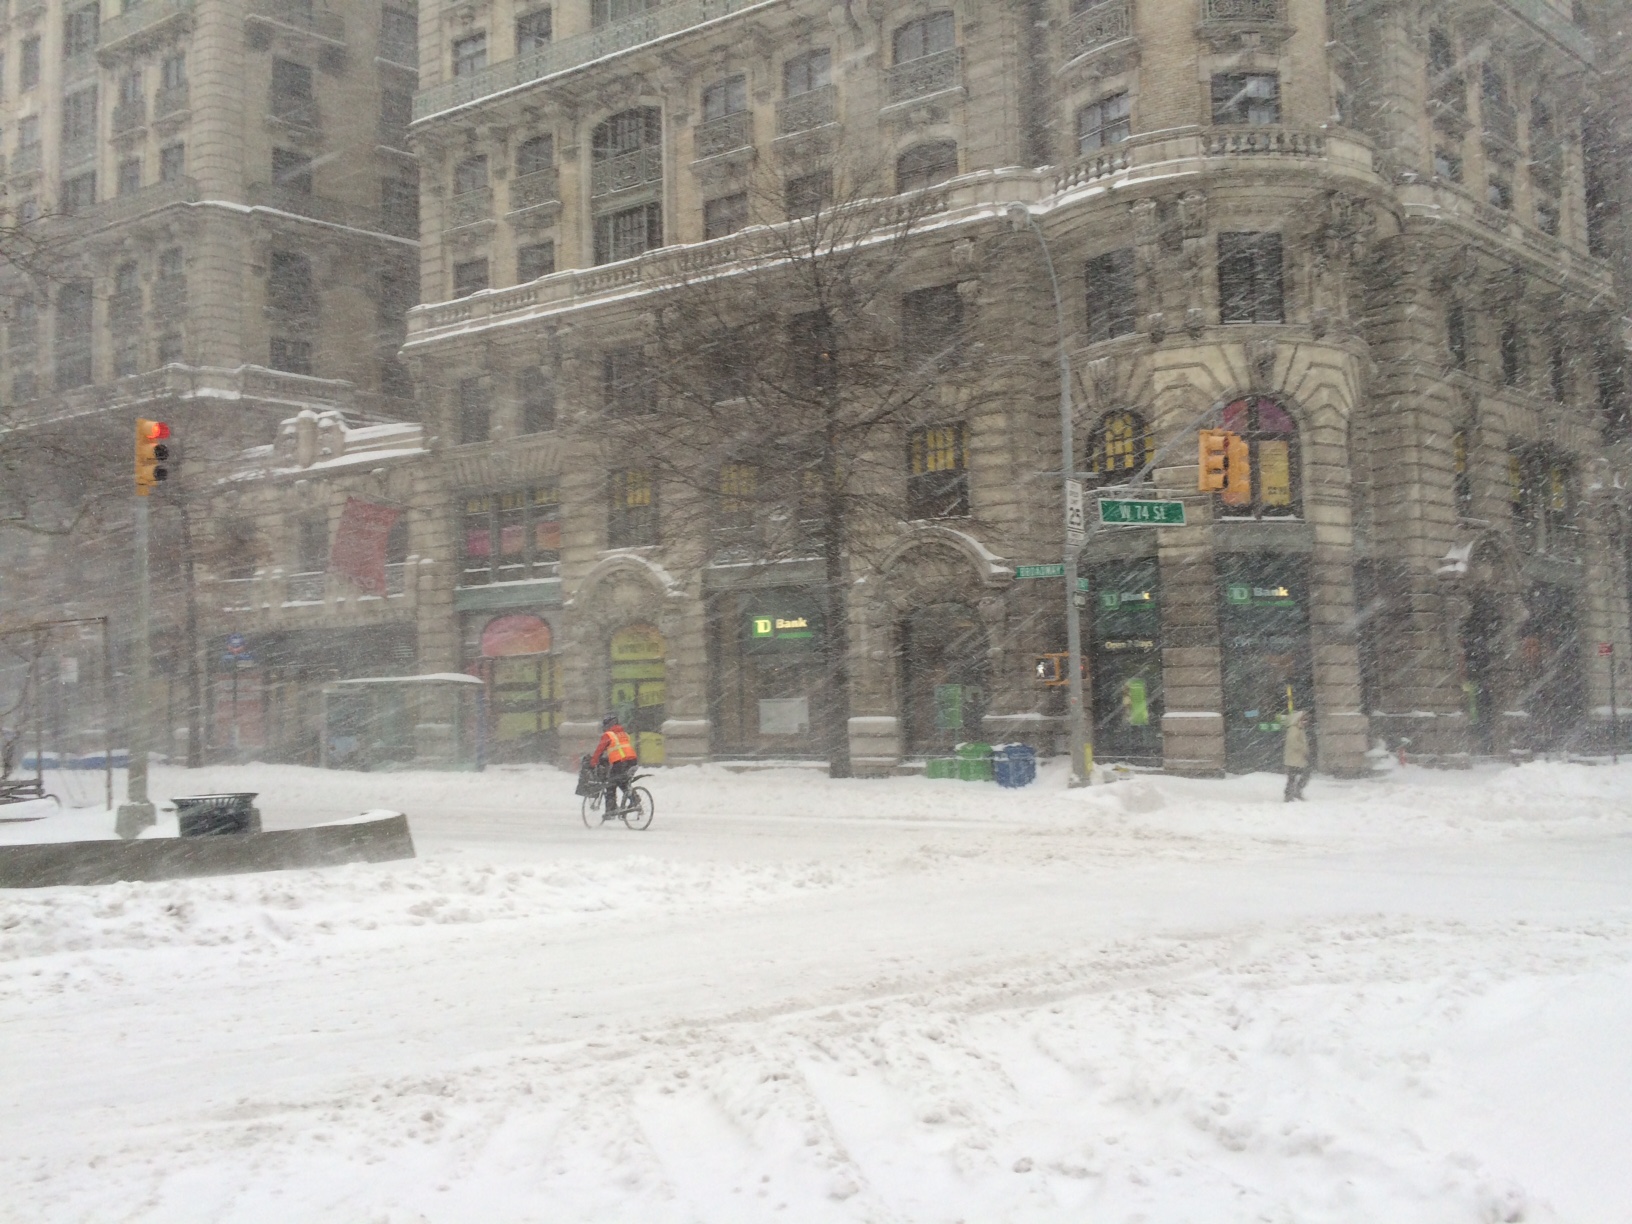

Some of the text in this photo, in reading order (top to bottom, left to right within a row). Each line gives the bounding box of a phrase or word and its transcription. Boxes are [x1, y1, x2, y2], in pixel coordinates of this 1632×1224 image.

[1069, 507, 1081, 526] 25
[1119, 505, 1131, 519] W
[1135, 505, 1150, 520] 74
[1019, 565, 1061, 577] BROADWAY
[1230, 586, 1290, 600] TD Bank
[755, 617, 808, 634] TD Bank
